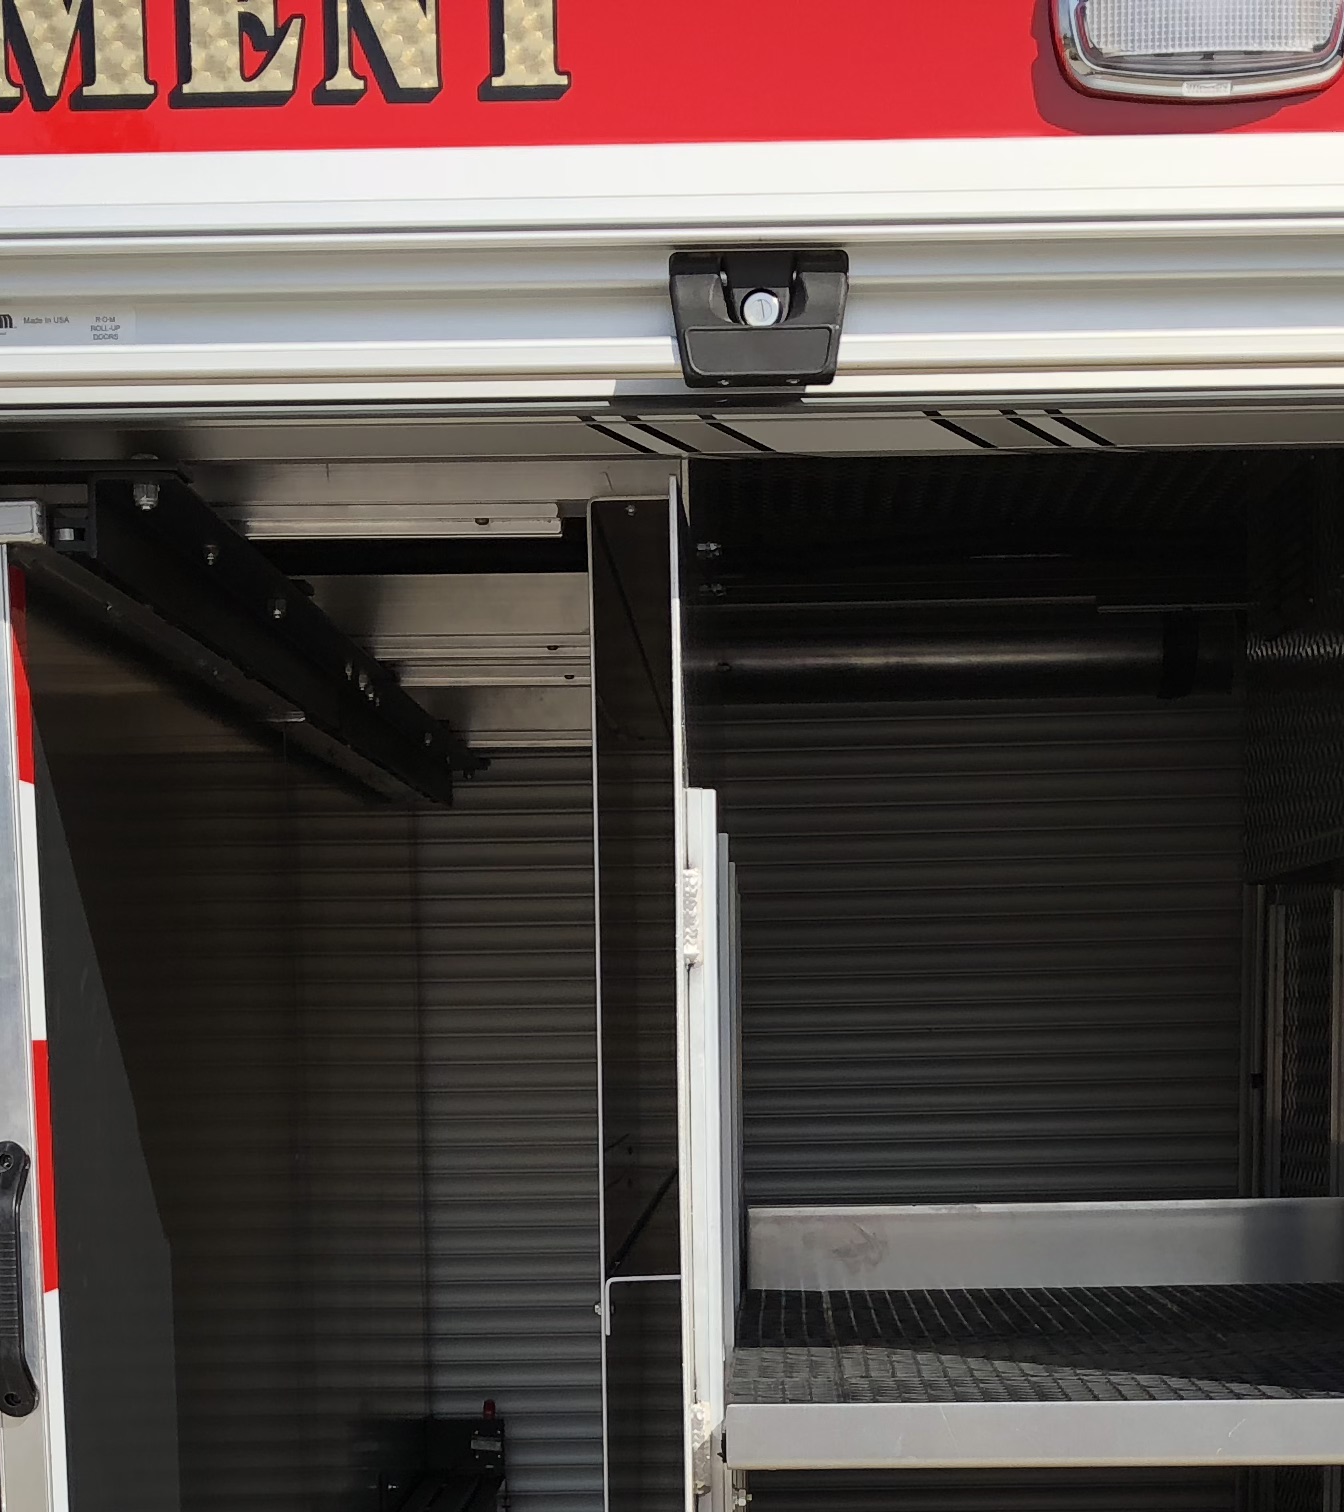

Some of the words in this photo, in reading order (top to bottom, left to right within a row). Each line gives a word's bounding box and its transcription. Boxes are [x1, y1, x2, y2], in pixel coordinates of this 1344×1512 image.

[23, 316, 43, 325] Made
[53, 316, 70, 324] USA
[92, 333, 119, 341] DOORS
